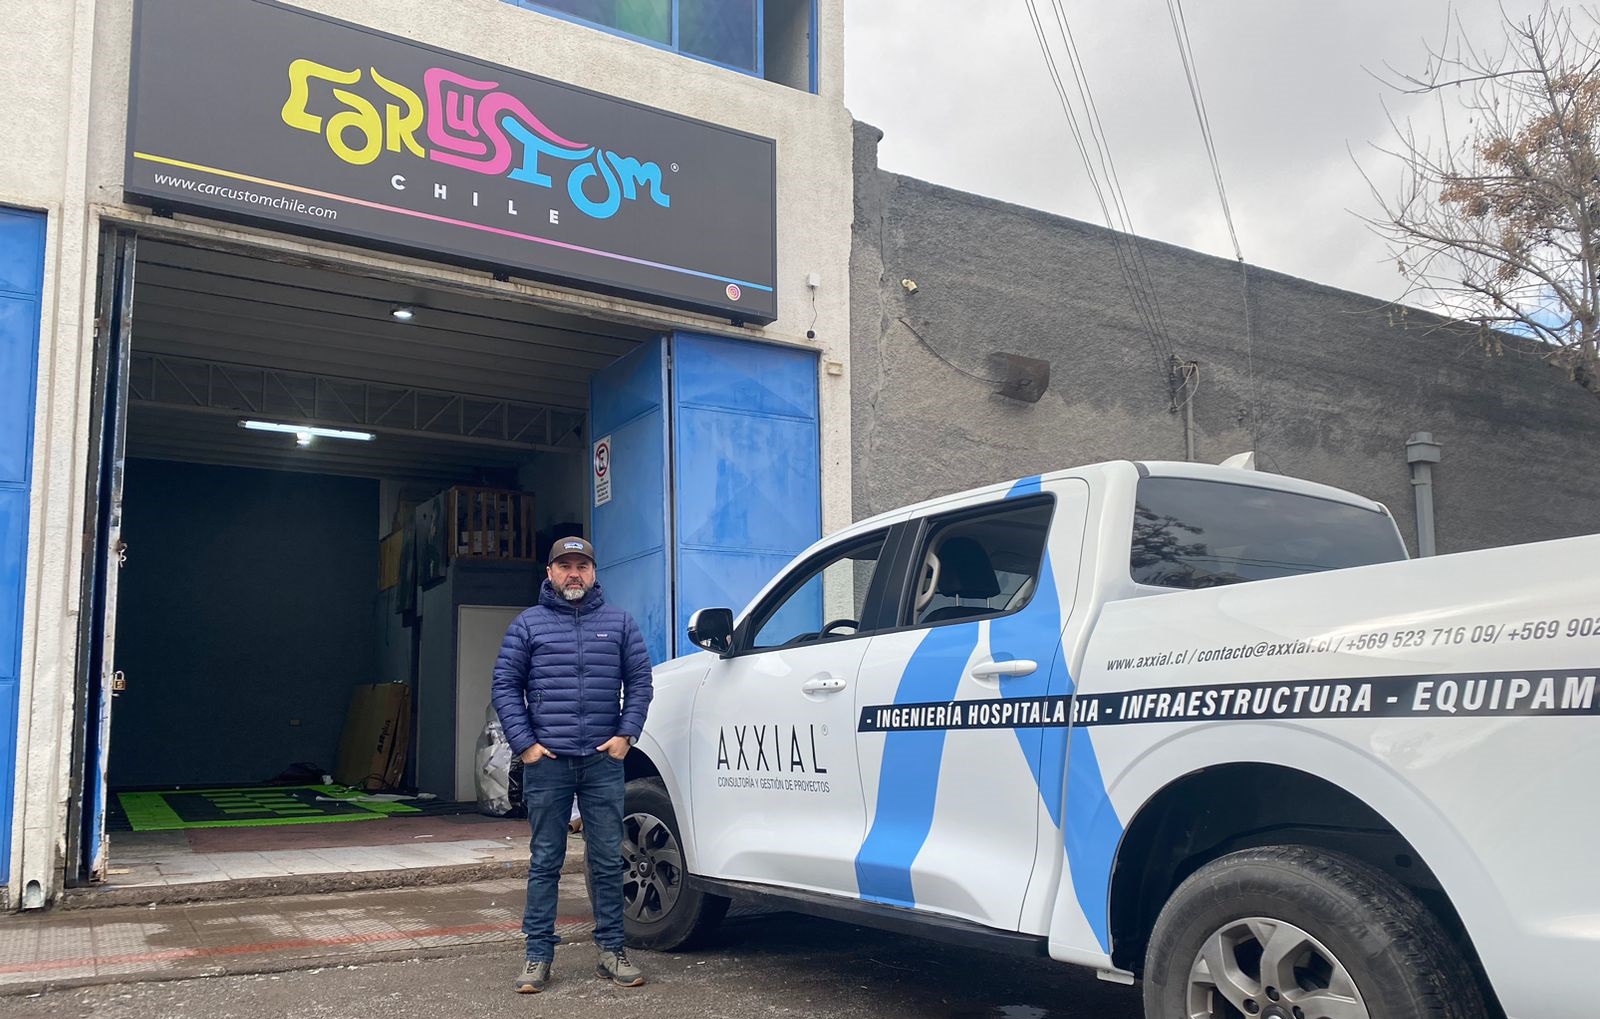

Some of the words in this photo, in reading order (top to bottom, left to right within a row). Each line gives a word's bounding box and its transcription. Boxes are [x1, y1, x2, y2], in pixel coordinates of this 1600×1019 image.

[154, 173, 338, 220] www.carcustomchile.com
[391, 174, 560, 225] CHILE
[1106, 650, 1187, 671] www.axxial.cl
[1197, 636, 1333, 663] contacto@axxial.cl
[1346, 632, 1389, 651] +569
[1392, 629, 1426, 648] 523
[1431, 627, 1466, 646] 716
[1508, 619, 1561, 641] +569
[876, 702, 963, 729] INGENIERÍA
[1119, 683, 1372, 720] INFRAESTRUCTURA
[717, 724, 828, 774] AXXIAL
[759, 776, 785, 790] GESTIÓN
[784, 779, 794, 791] DE
[794, 779, 831, 793] PROYECTOS
